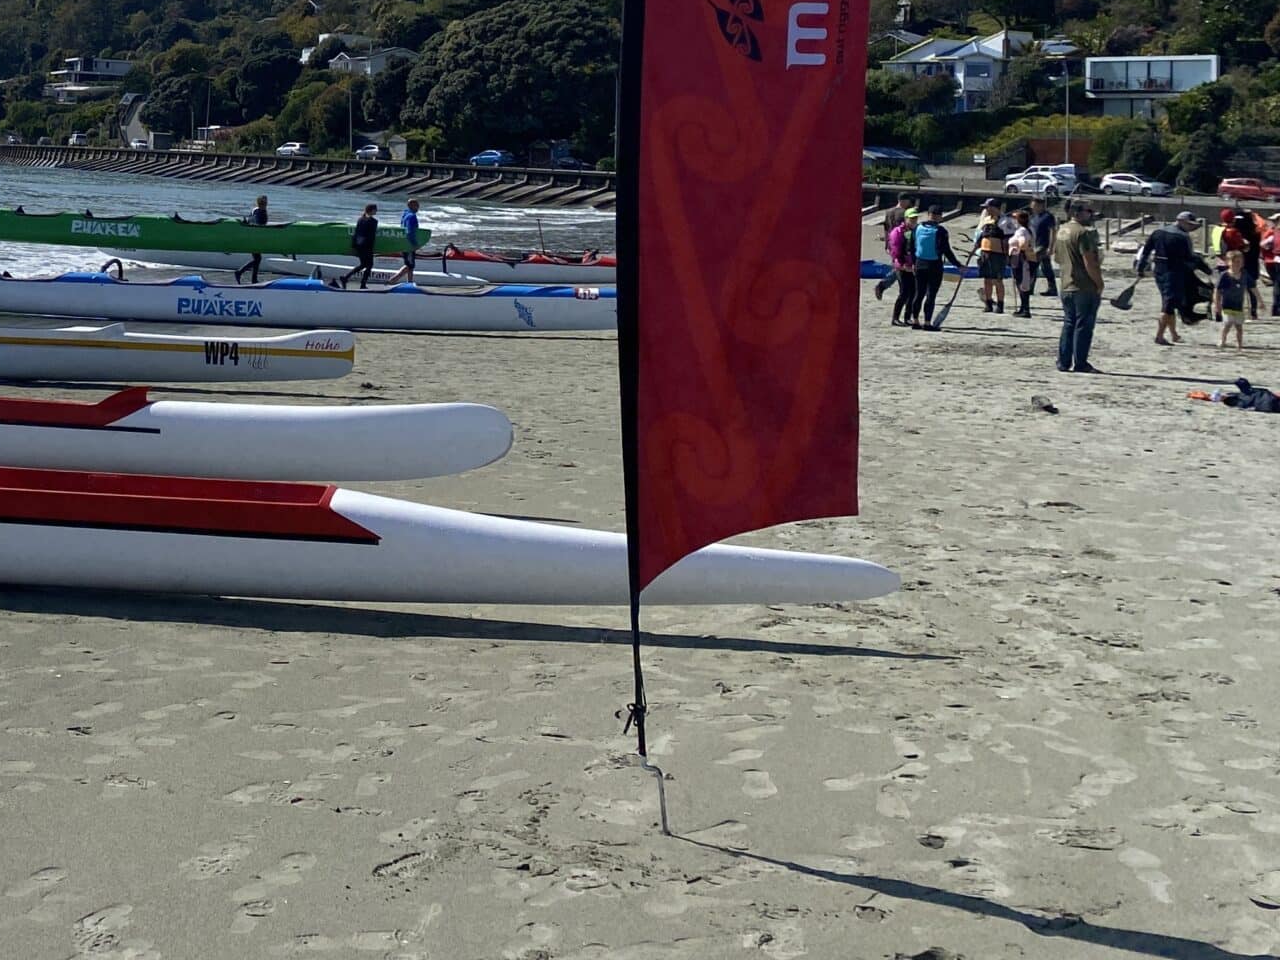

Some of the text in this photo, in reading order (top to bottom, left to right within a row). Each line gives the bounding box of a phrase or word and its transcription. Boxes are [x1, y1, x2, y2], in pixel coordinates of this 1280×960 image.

[71, 220, 141, 237] PUAKEA
[177, 297, 263, 317] PUAKEA
[204, 341, 239, 366] WP4
